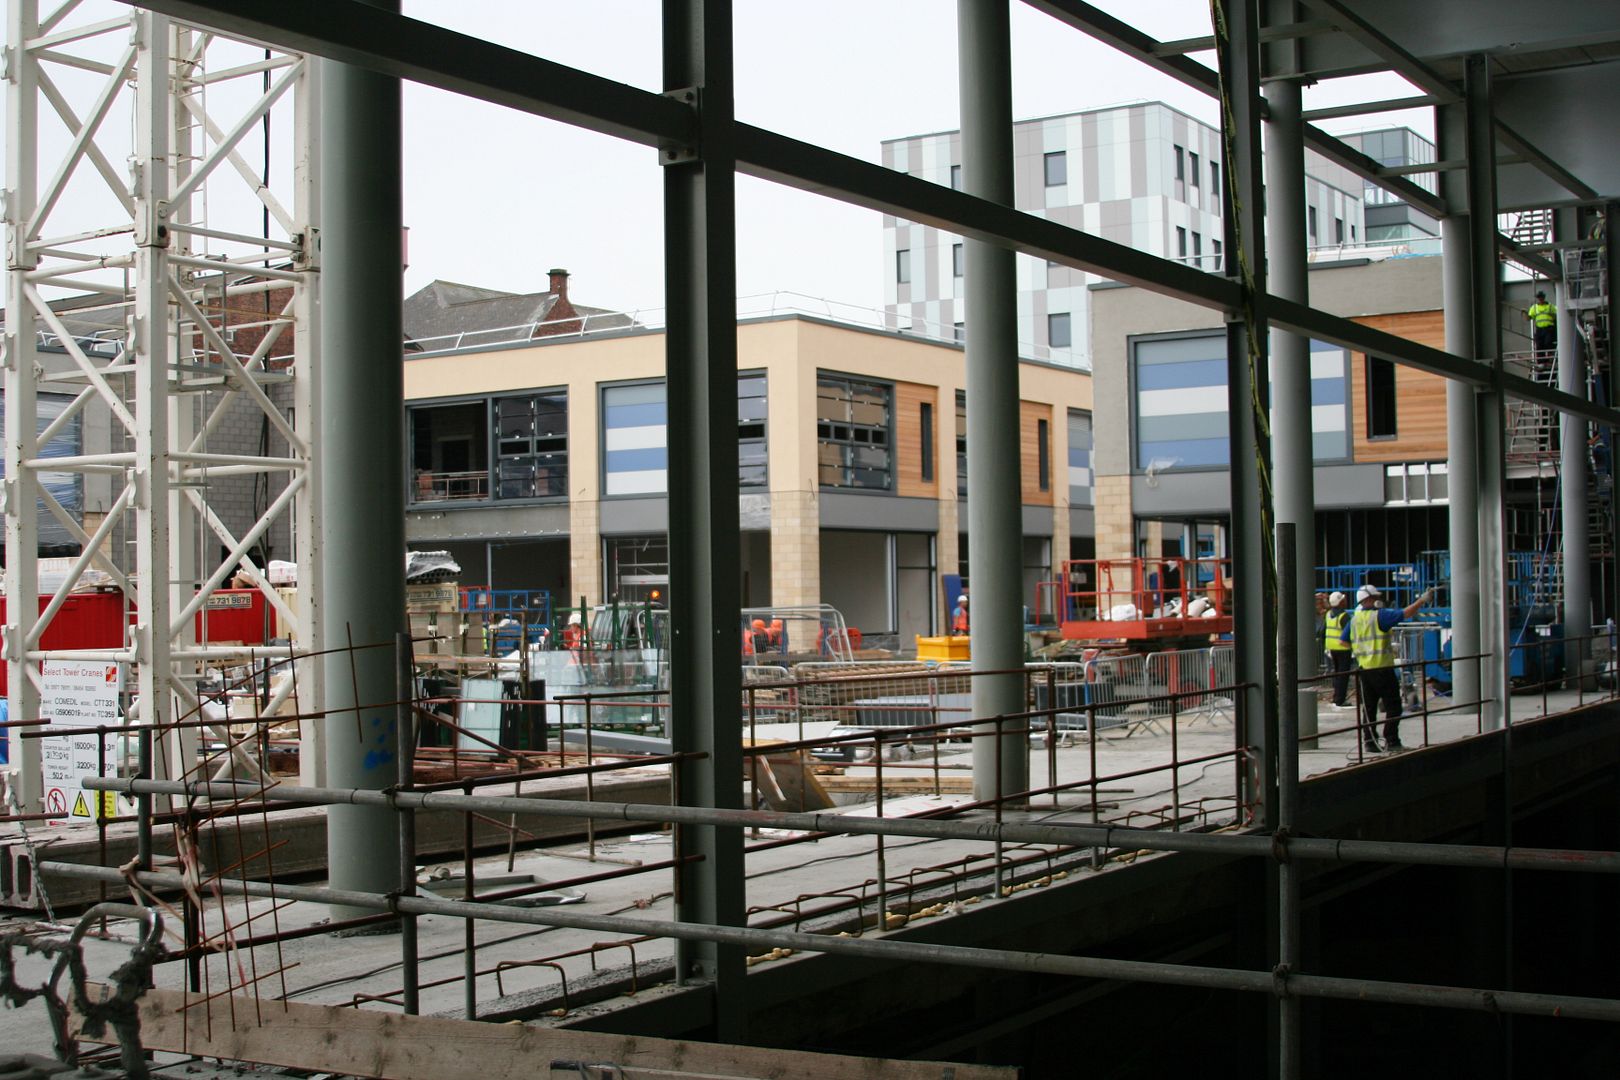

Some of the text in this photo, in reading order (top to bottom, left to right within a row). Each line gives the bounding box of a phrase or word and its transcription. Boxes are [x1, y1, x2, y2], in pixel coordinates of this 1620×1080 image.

[43, 668, 104, 678] Select Tower Cranes
[54, 697, 78, 706] COMEDIL
[94, 699, 115, 708] CTT331
[97, 710, 115, 718] TC359
